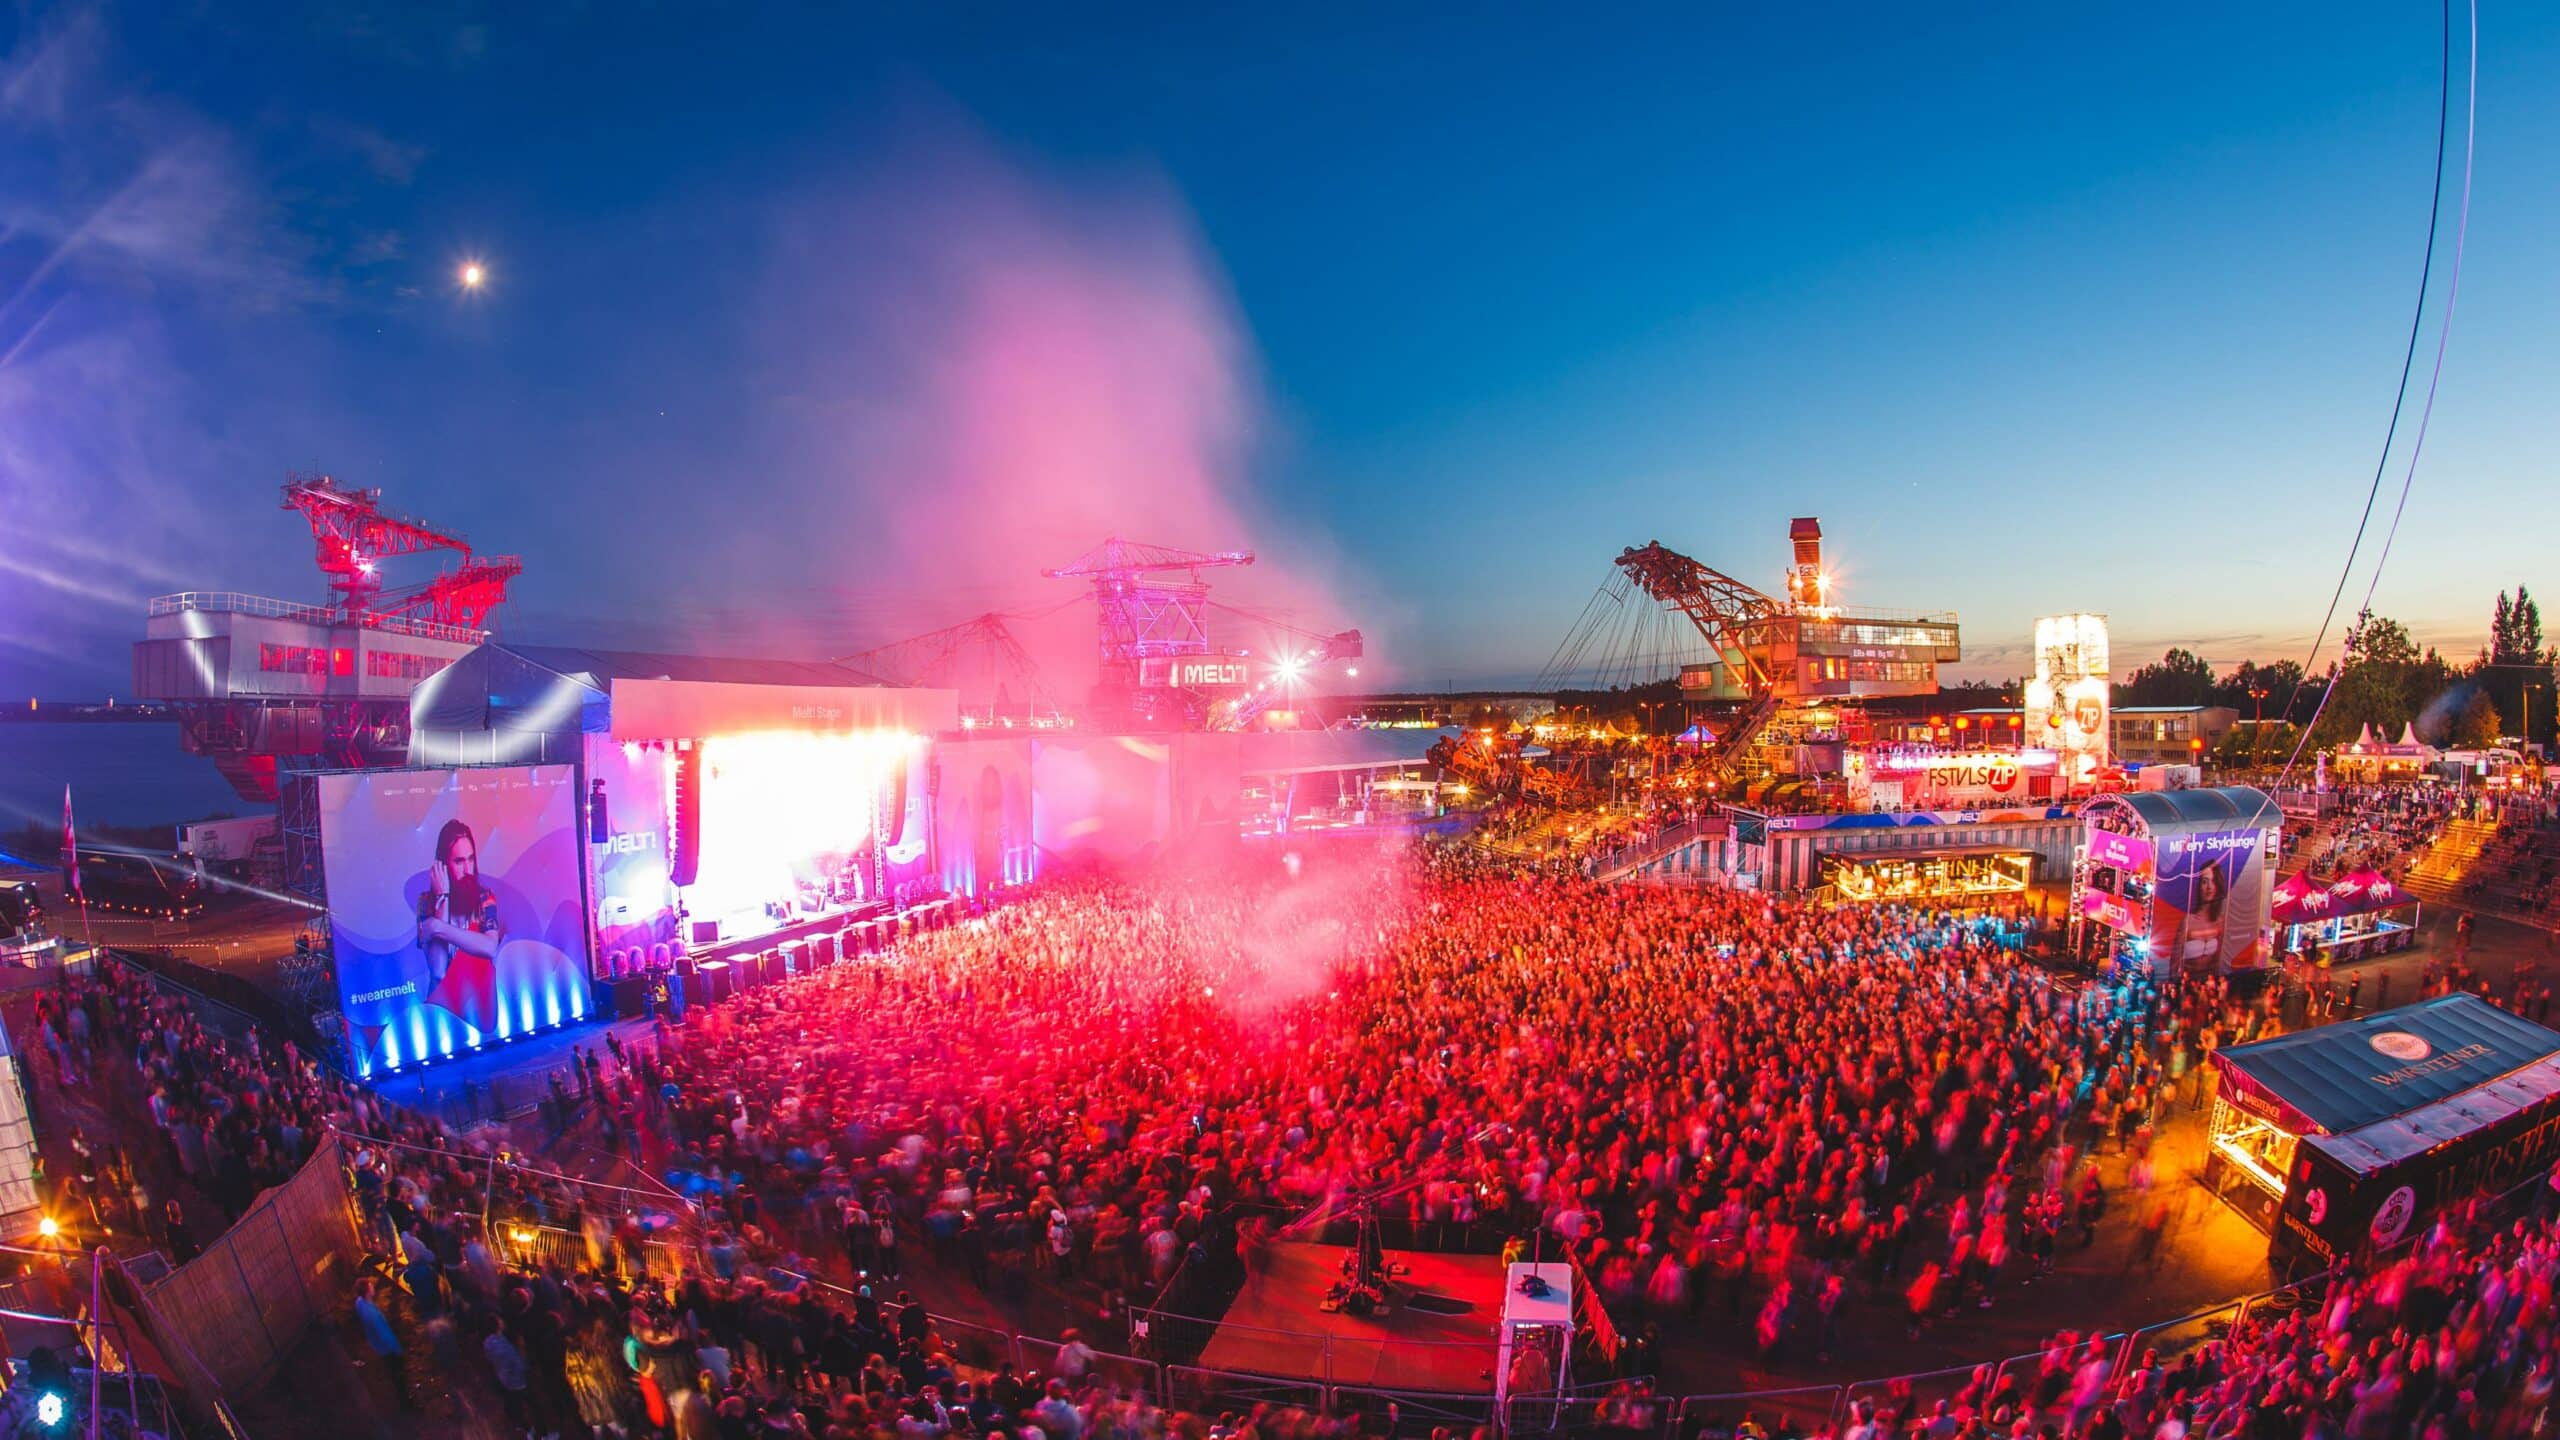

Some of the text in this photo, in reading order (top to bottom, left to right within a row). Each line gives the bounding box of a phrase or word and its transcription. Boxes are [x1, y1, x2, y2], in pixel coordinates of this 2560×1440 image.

[1185, 664, 1247, 684] MELT!
[2080, 707, 2099, 728] ZIP
[351, 980, 417, 1005] #wearemelt
[2370, 1043, 2492, 1086] WARSTEINER
